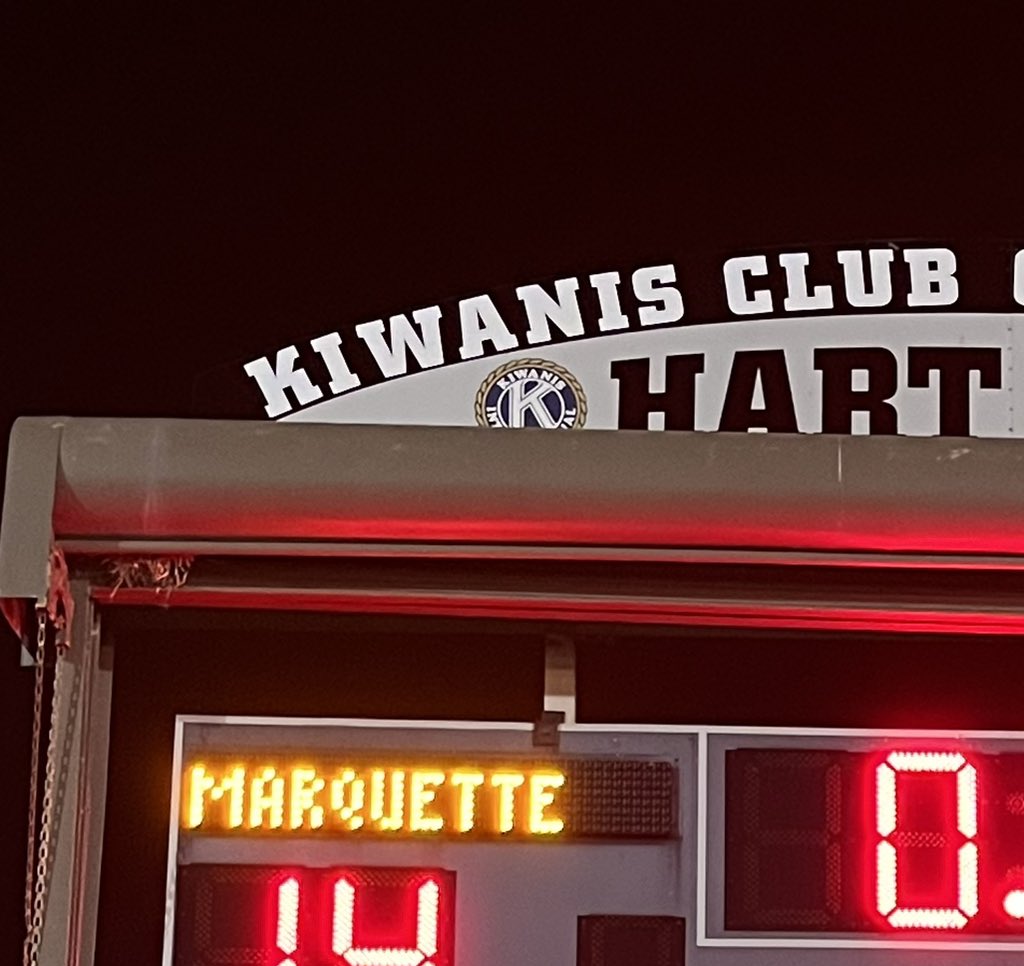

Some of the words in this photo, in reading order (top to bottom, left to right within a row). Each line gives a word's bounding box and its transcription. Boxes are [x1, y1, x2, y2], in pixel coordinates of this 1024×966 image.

[244, 264, 686, 419] KIWANIS
[722, 247, 960, 316] CLUB
[496, 368, 567, 390] KIWANIS
[610, 347, 1002, 436] HART
[186, 764, 567, 834] MARQUETTE
